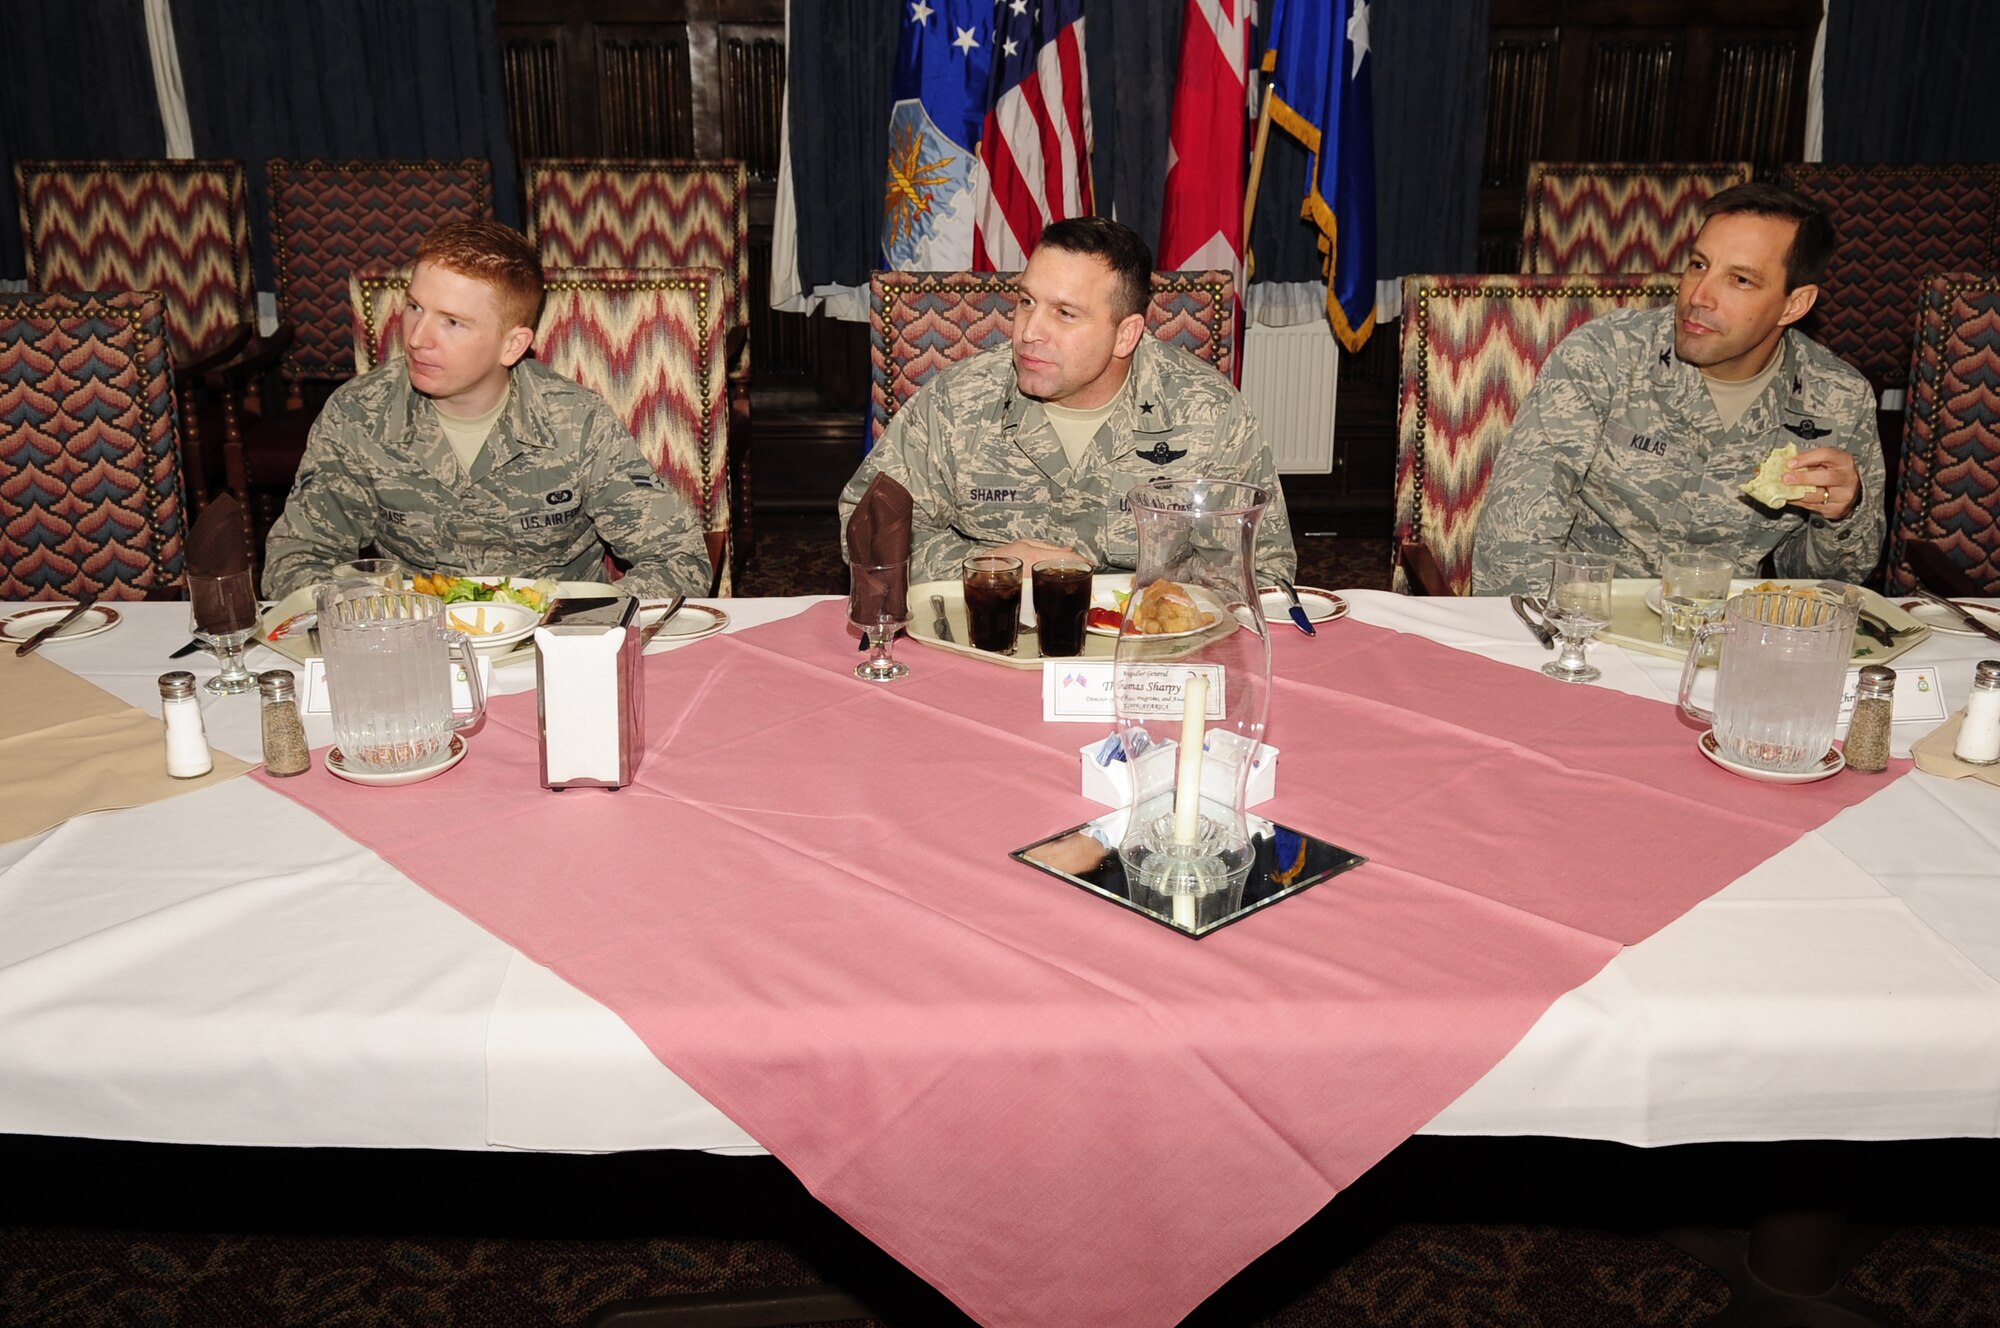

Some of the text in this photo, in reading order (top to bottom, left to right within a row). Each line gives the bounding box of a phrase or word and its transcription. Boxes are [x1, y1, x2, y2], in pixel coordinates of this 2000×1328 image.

[1630, 433, 1667, 457] KULAS
[970, 488, 1016, 502] SHARPY
[520, 516, 543, 530] U.S.
[544, 512, 563, 527] AIR
[1146, 670, 1169, 678] General
[1146, 681, 1182, 695] Sharpy
